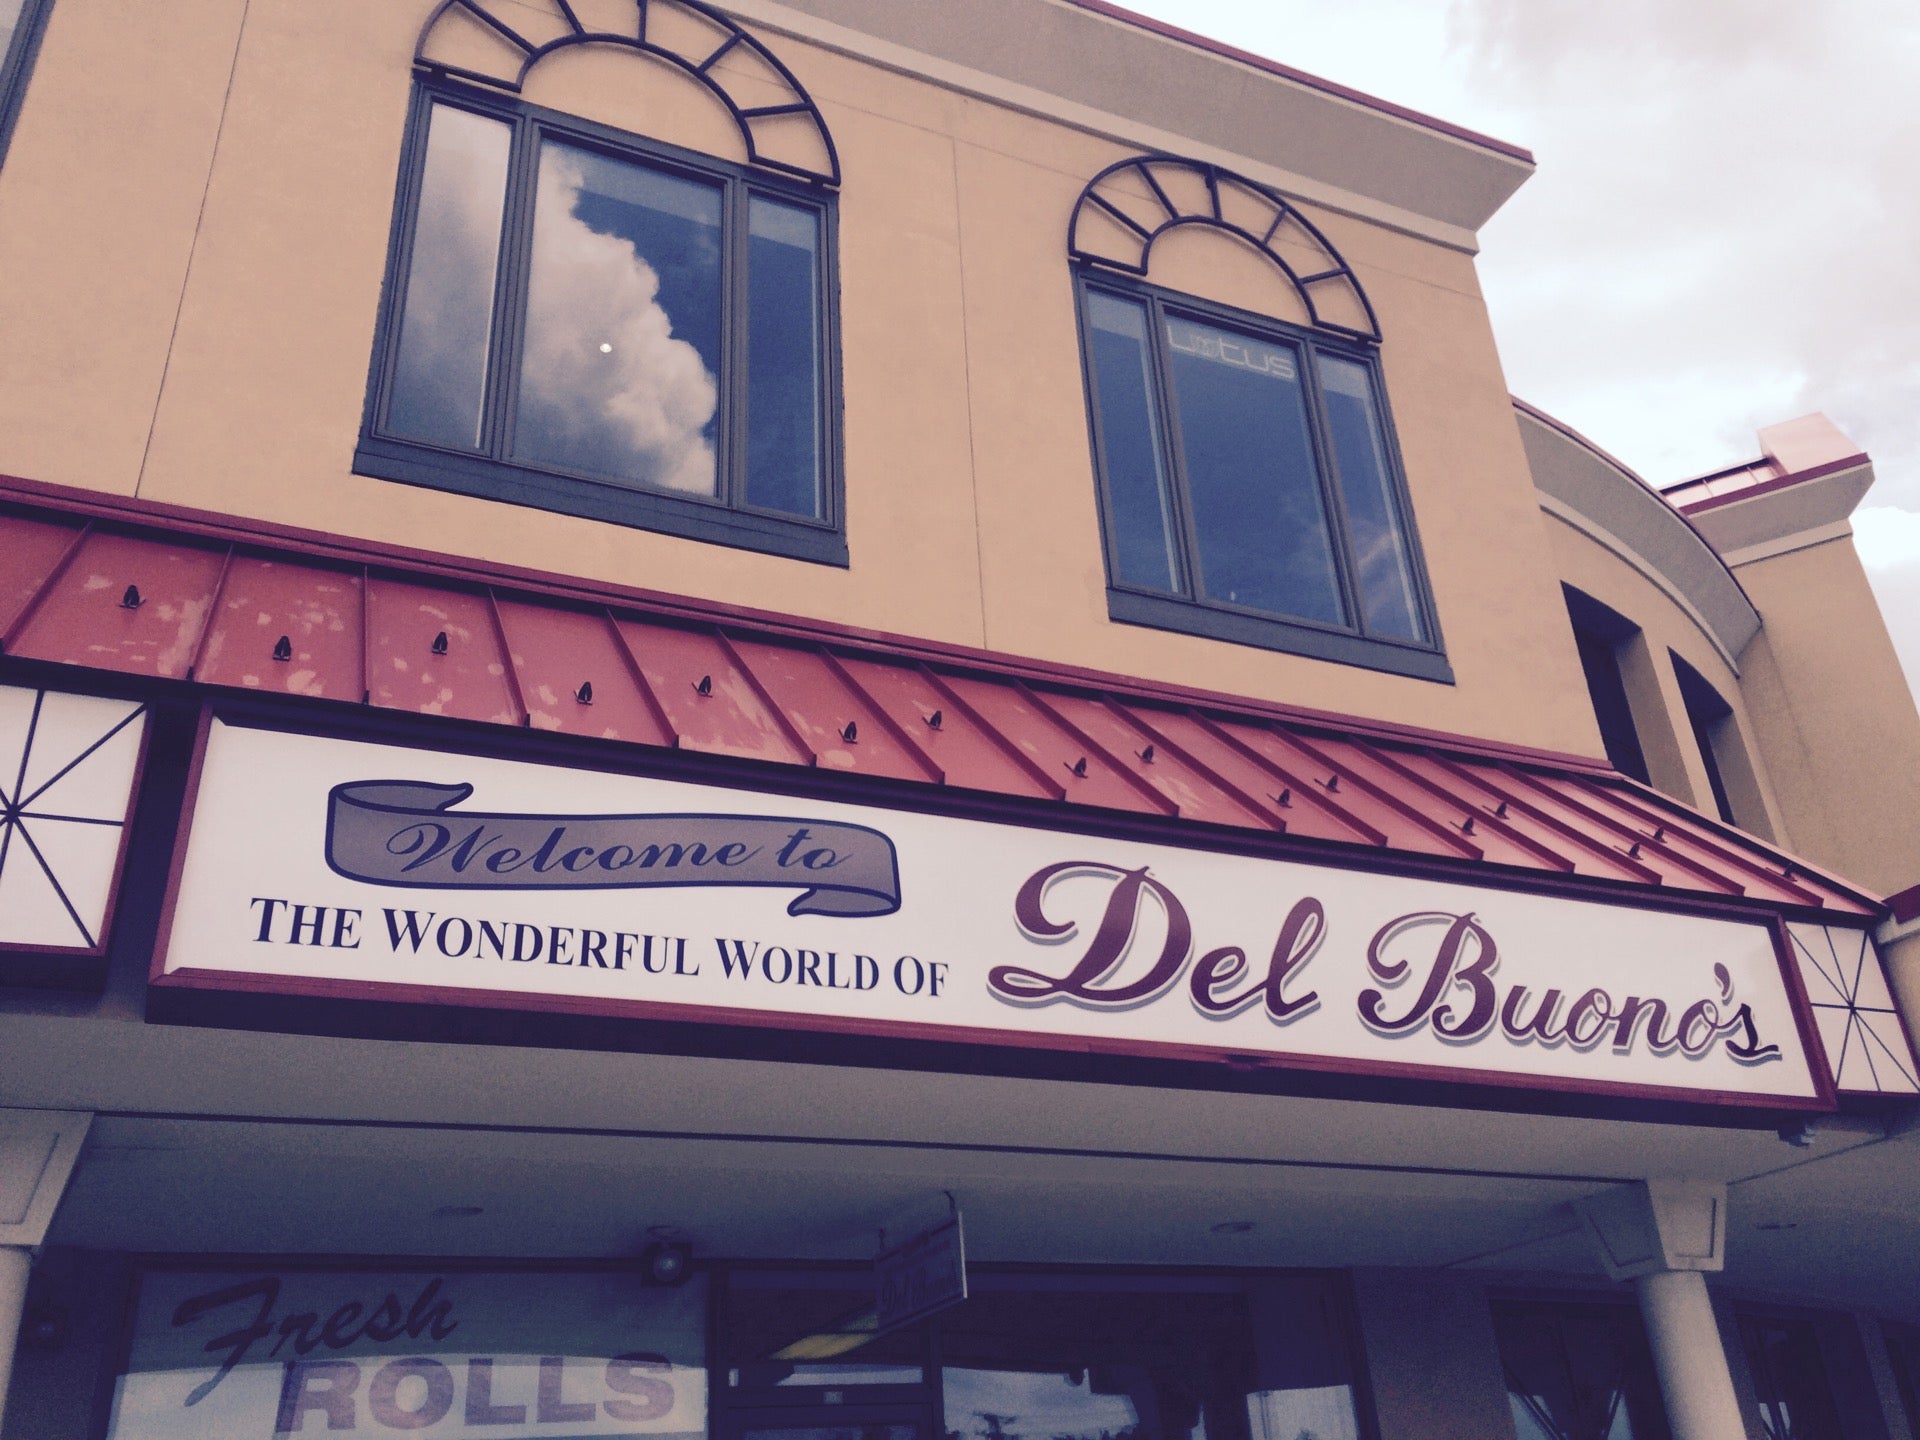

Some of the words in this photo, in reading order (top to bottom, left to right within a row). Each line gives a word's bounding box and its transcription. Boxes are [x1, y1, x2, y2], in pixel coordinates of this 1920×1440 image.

[387, 822, 763, 875] Welcome
[774, 827, 855, 870] to
[250, 897, 363, 950] THE
[380, 908, 701, 977] WONDERFUL
[714, 938, 880, 992] WORLD
[893, 955, 950, 998] OF
[986, 858, 1325, 1025] Del
[1356, 910, 1784, 1065] Buono's
[171, 1277, 460, 1408] Fresh
[275, 1352, 676, 1433] ROLLS
